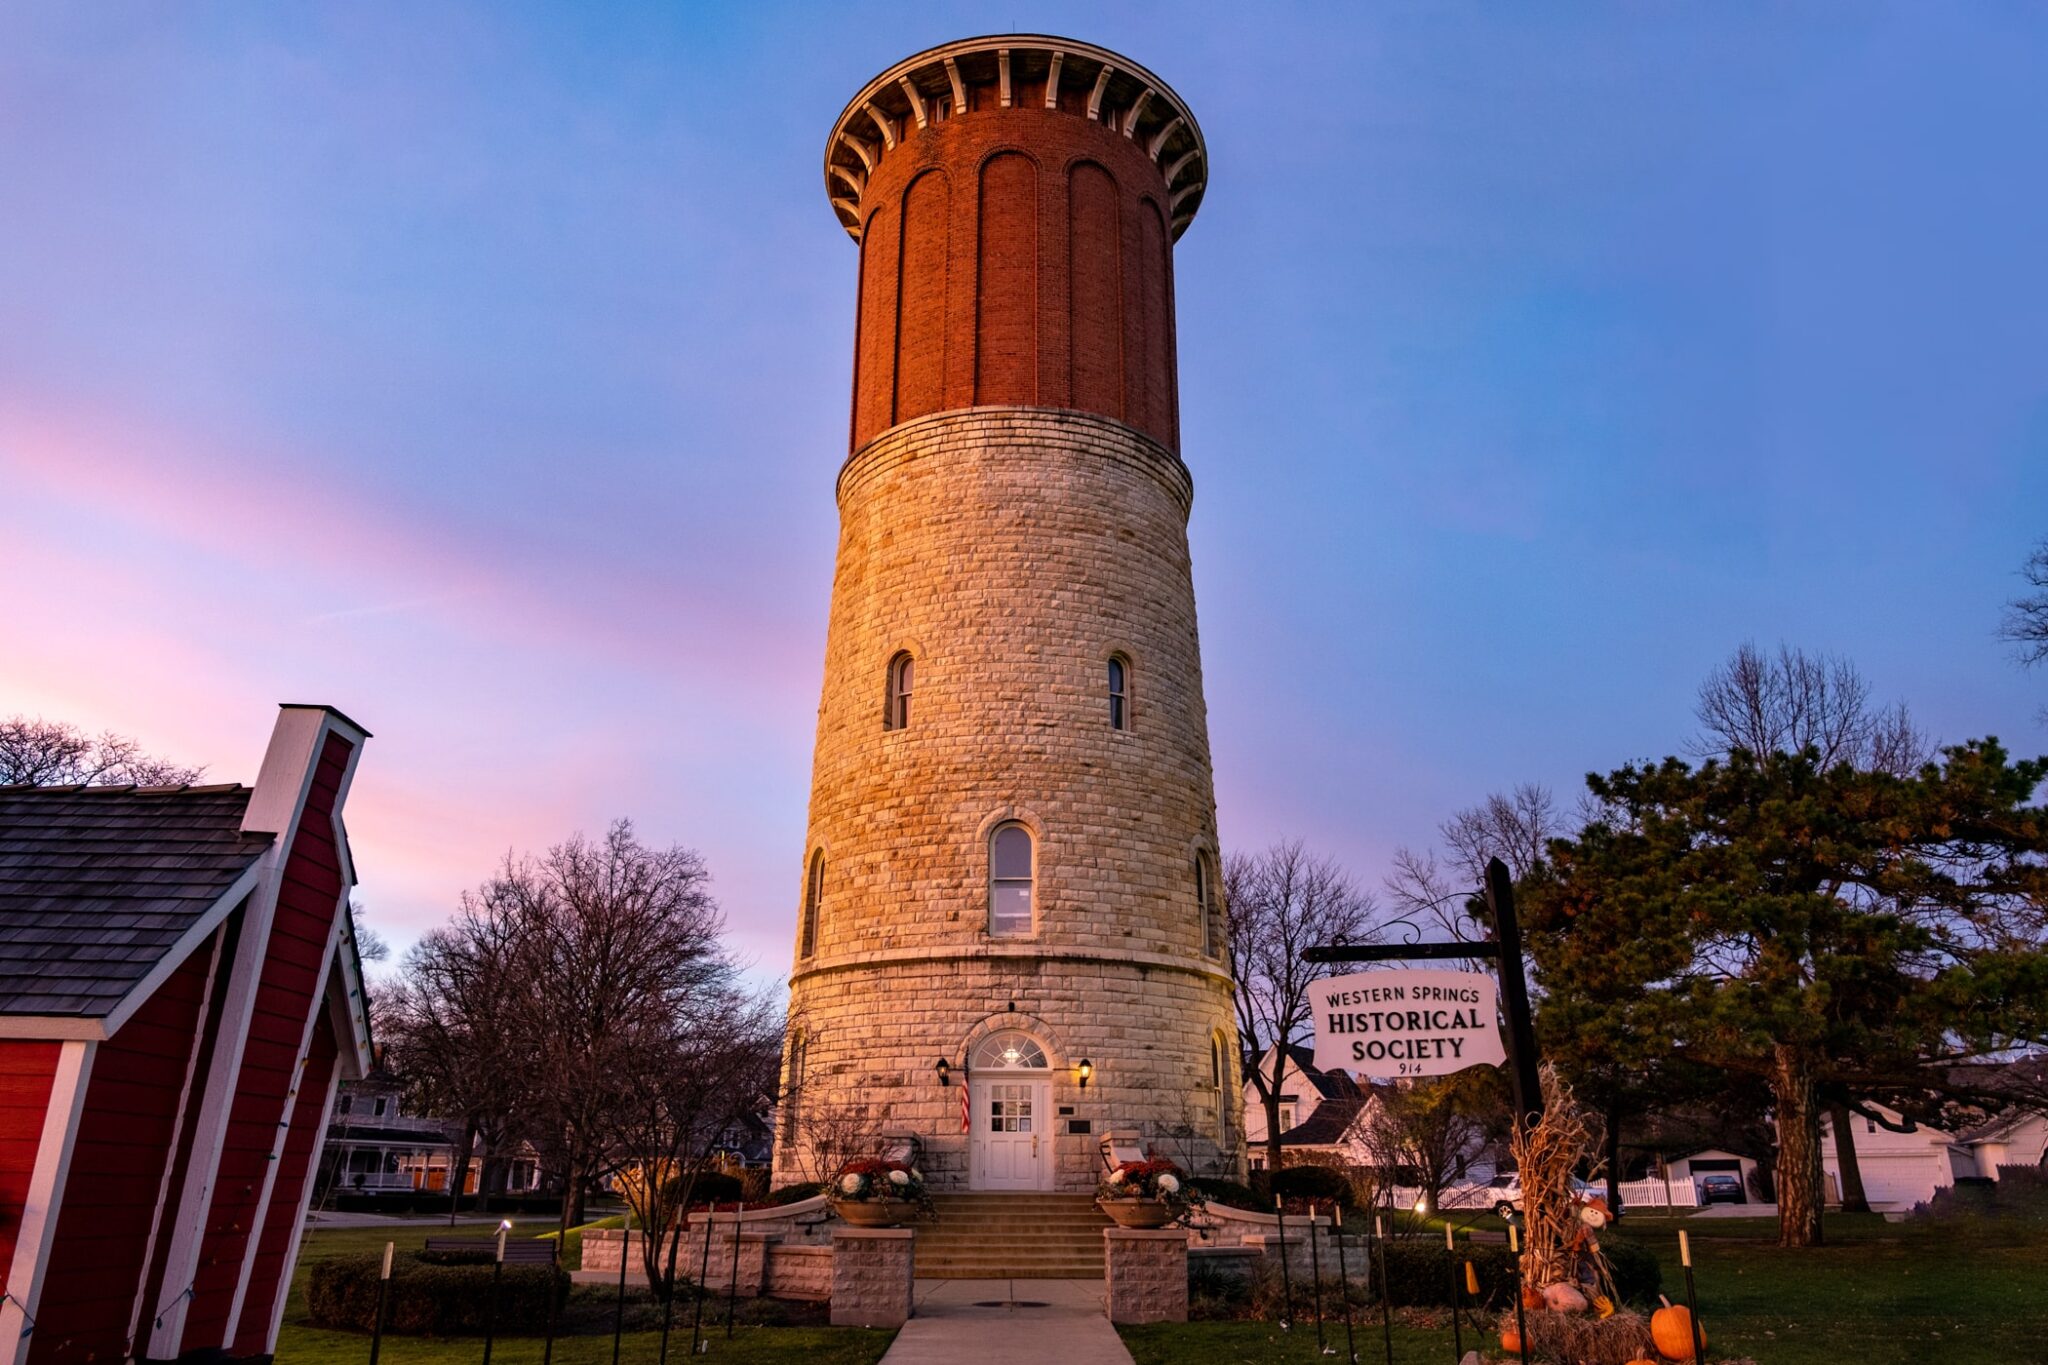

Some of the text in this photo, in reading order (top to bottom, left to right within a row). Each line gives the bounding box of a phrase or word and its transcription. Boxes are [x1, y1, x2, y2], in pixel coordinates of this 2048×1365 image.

[1326, 986, 1480, 1008] WESTERN SPRINGS
[1328, 1009, 1485, 1033] HISTORICAL
[1352, 1038, 1465, 1060] SOCIETY
[1399, 1063, 1422, 1075] 914
